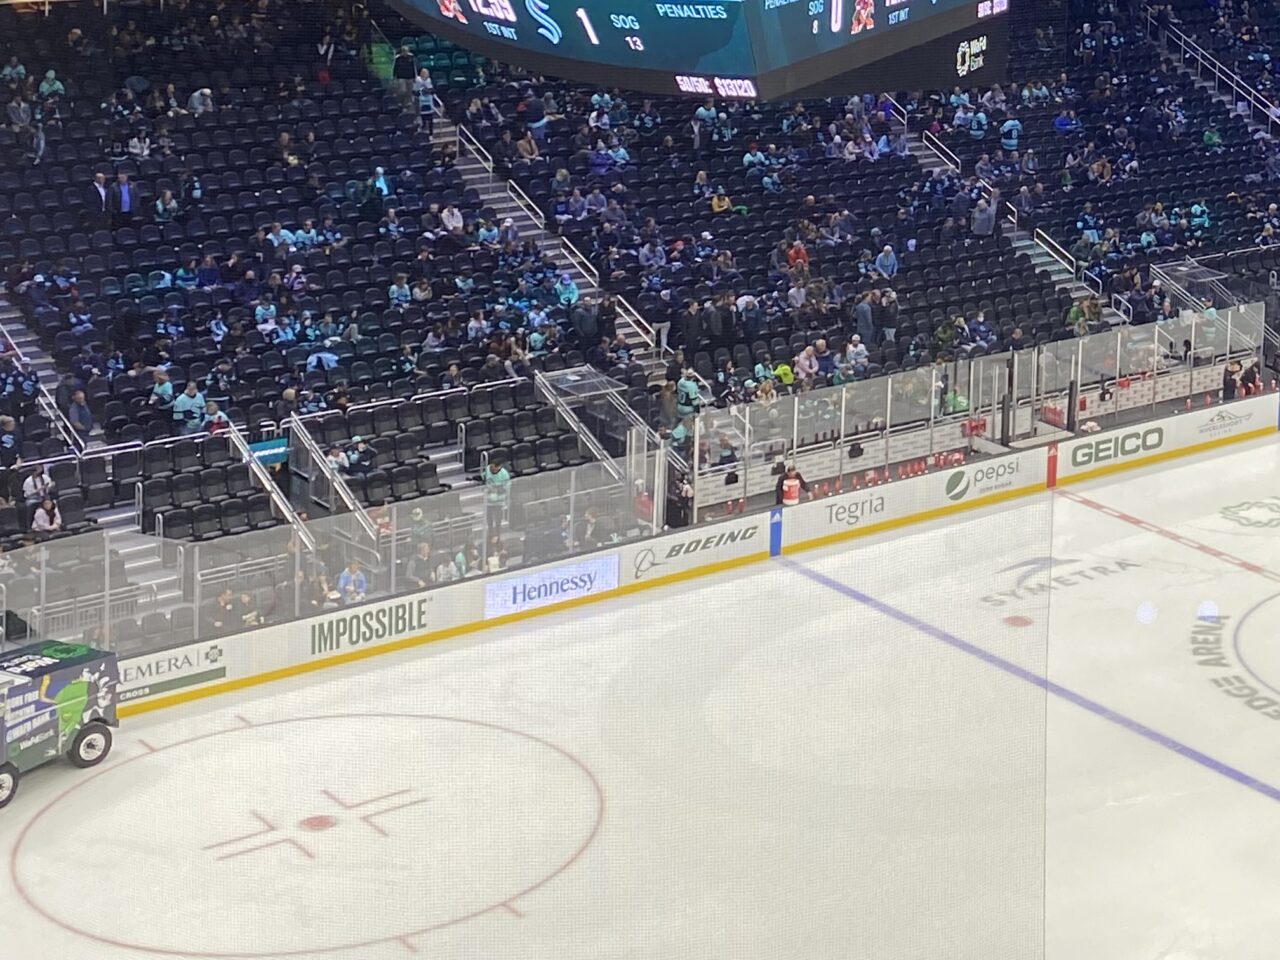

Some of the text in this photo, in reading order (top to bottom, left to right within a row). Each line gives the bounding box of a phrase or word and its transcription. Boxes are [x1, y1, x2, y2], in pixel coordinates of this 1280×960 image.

[576, 8, 599, 45] 1
[610, 14, 640, 30] SOG
[657, 4, 728, 19] PENALTIES
[625, 36, 644, 51] 13
[1071, 427, 1164, 467] GEICO
[974, 456, 1020, 487] pepsi
[825, 494, 885, 526] Tegria
[665, 526, 758, 560] BOEING
[511, 569, 597, 605] Hennessy
[979, 558, 1143, 609] SYMETRA
[311, 598, 428, 655] IMPOSSIBLE
[1190, 614, 1233, 669] ARENA
[122, 654, 192, 682] EMERA
